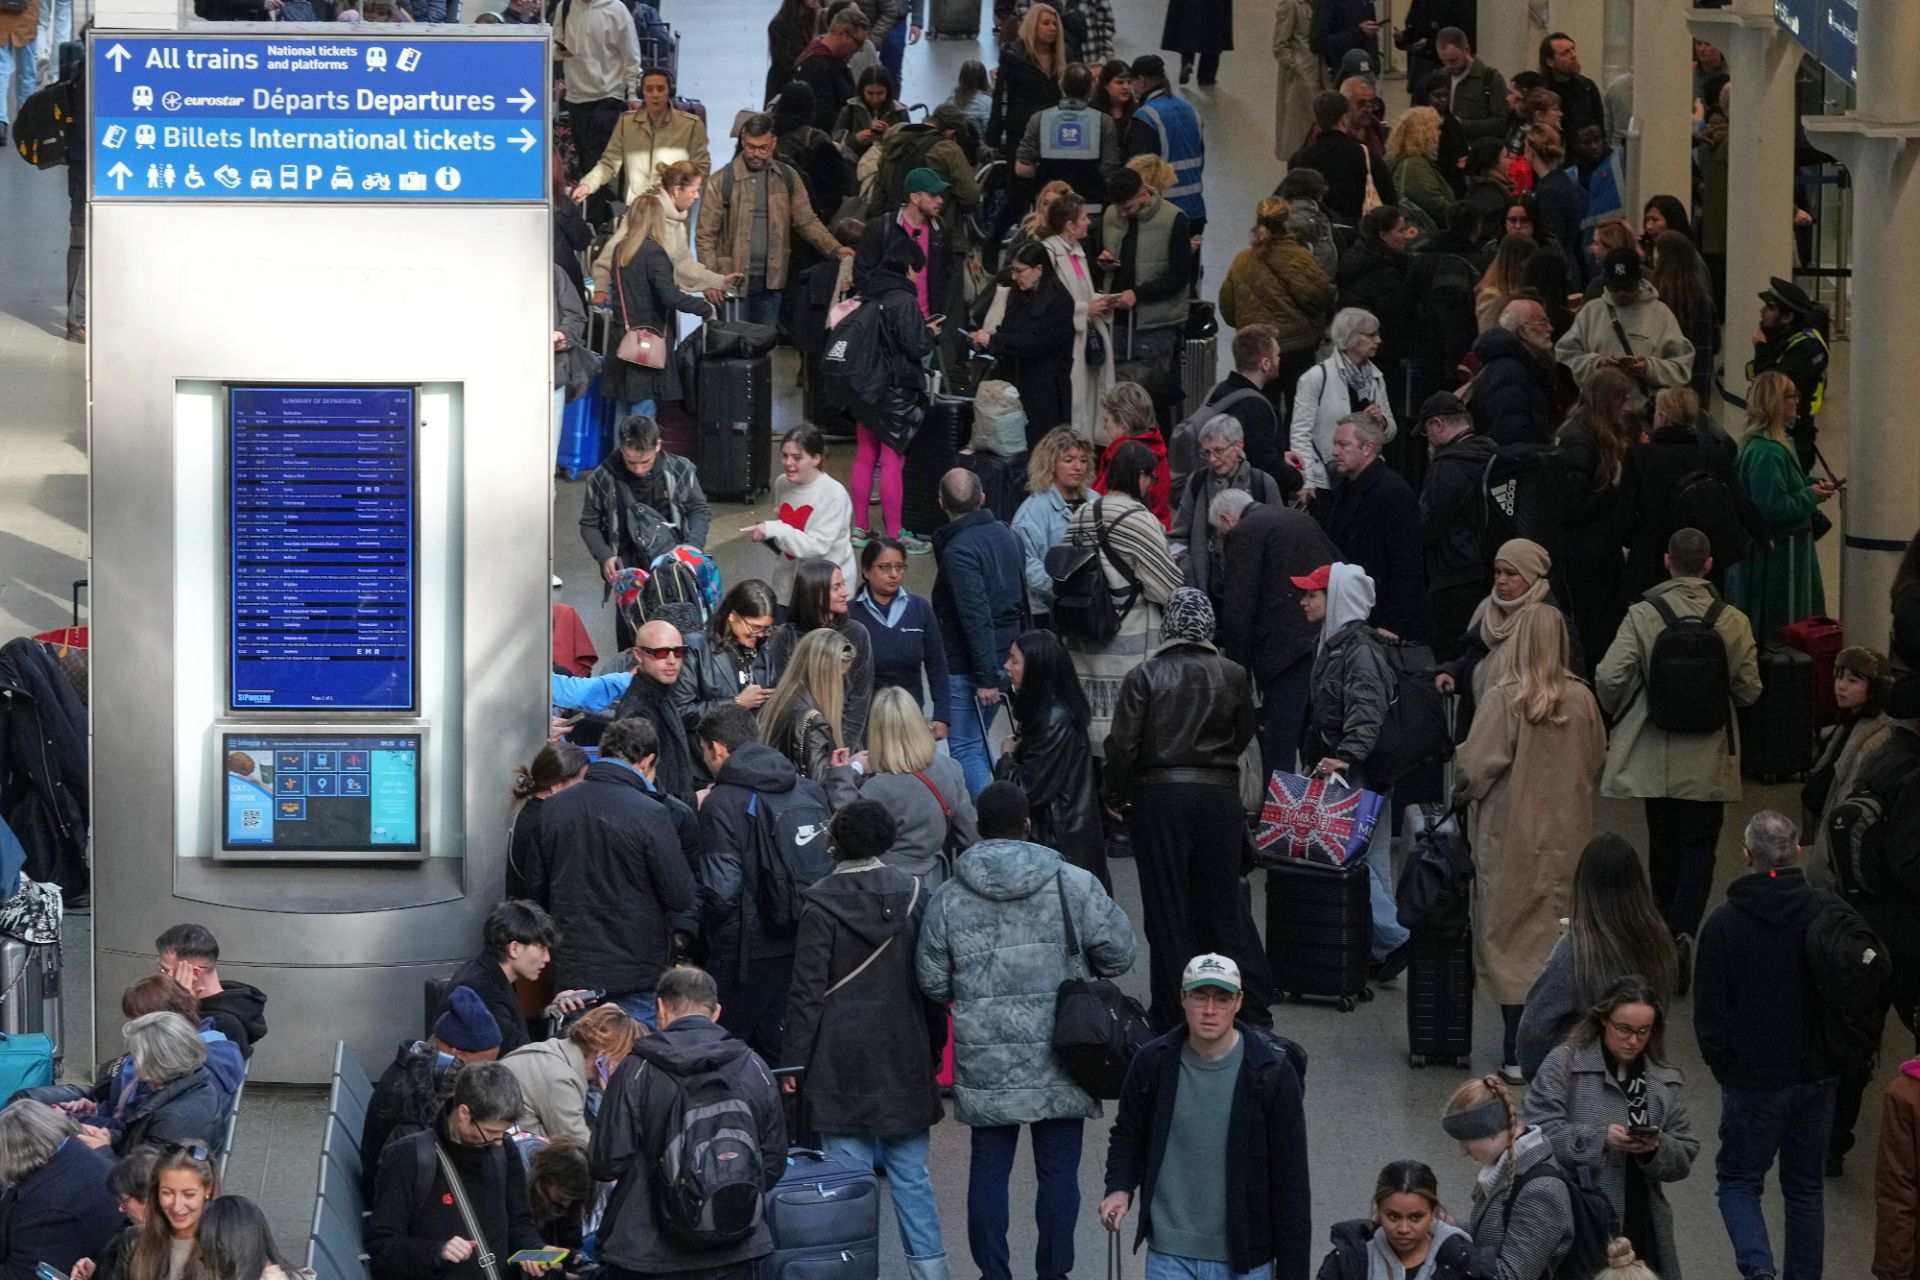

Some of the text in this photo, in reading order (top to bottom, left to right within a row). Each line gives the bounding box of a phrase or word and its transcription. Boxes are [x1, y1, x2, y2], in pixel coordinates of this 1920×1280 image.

[145, 47, 259, 69] All trains
[267, 45, 358, 57] National tickets
[266, 59, 349, 72] and platforms
[183, 87, 496, 116] eurostar Départs Departures
[164, 126, 496, 151] Billets International tickets
[1505, 479, 1517, 516] adidas
[1293, 811, 1318, 825] M&S
